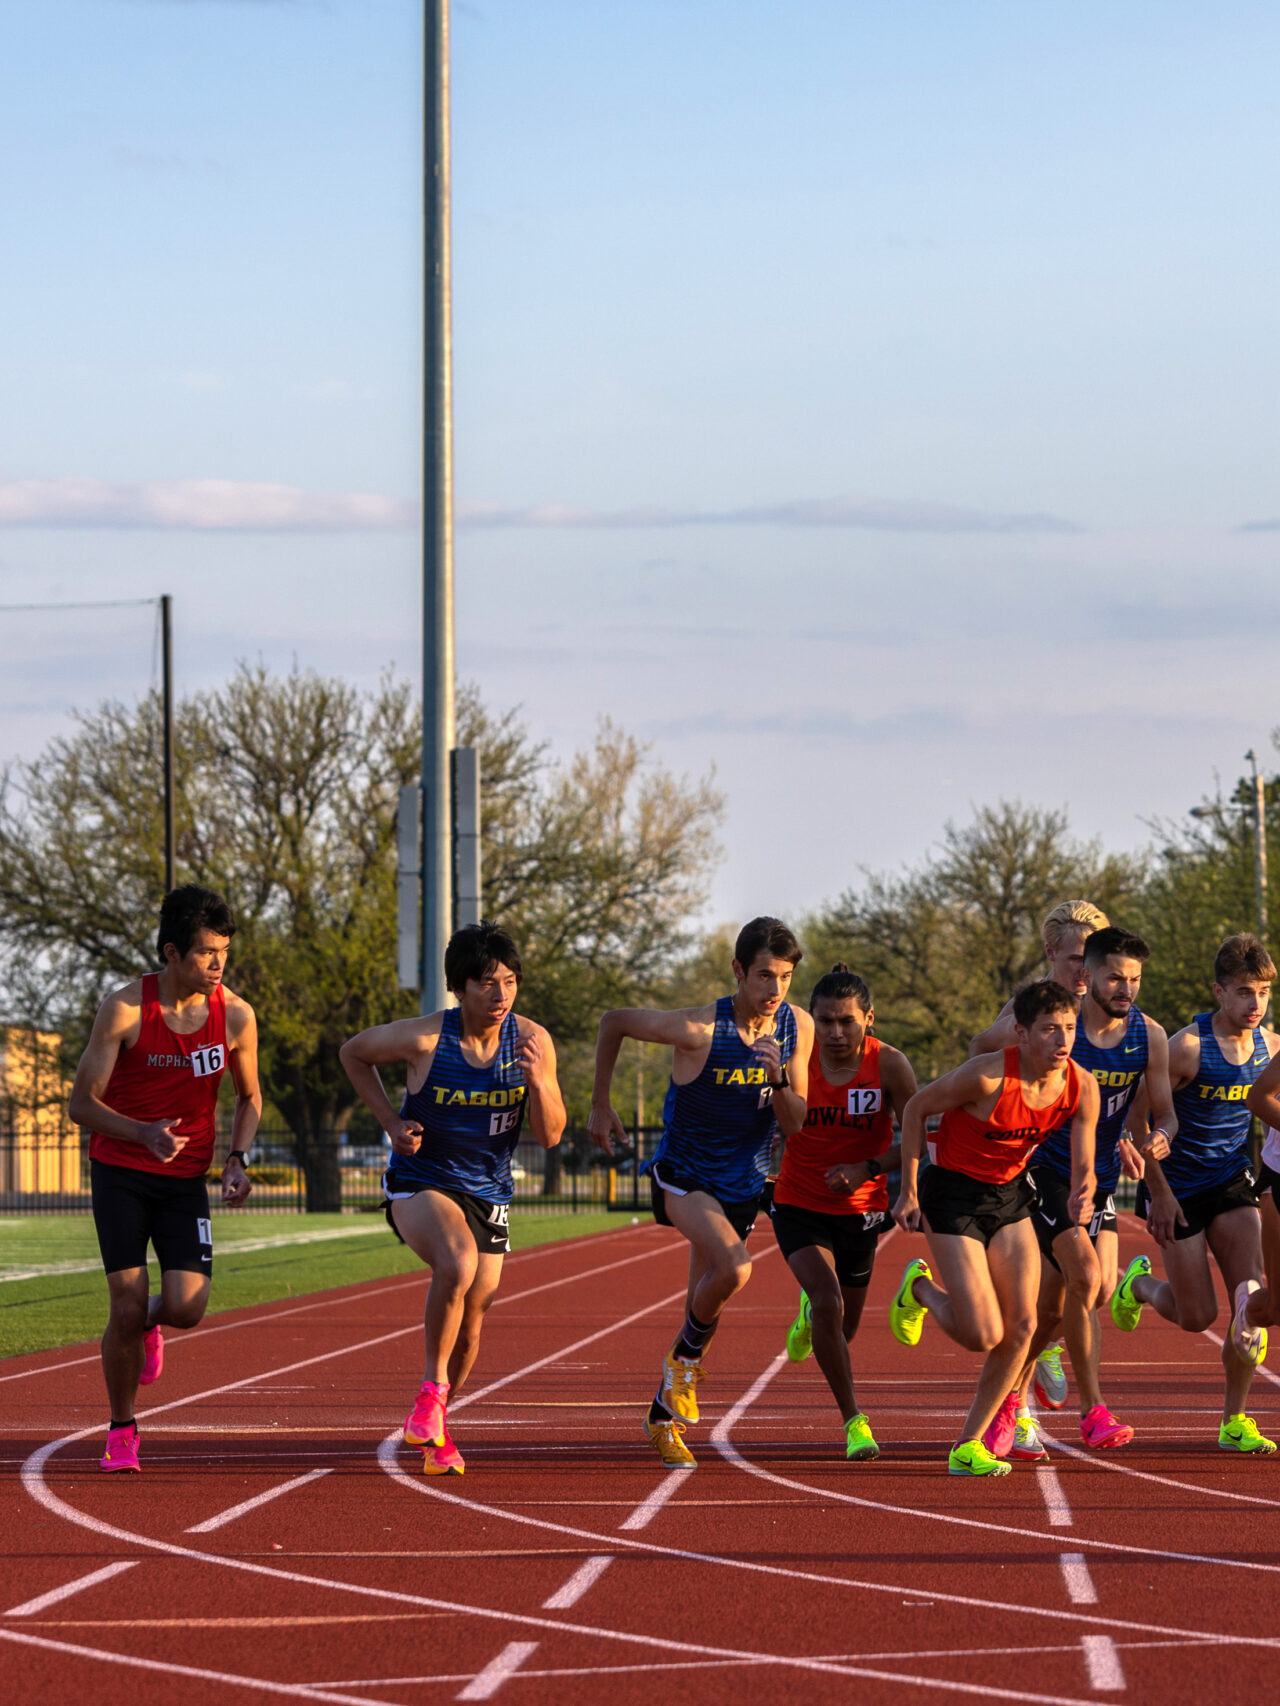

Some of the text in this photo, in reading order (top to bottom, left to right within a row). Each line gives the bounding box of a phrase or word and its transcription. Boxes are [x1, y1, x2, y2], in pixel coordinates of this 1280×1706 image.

[146, 1053, 193, 1067] MCPHE
[194, 1047, 220, 1075] 16
[712, 1063, 787, 1085] TAB
[433, 1085, 525, 1107] TABOR
[850, 1090, 878, 1114] 12
[1198, 1083, 1253, 1101] TAB
[493, 1111, 517, 1134] 15
[802, 1105, 875, 1131] OWLEY
